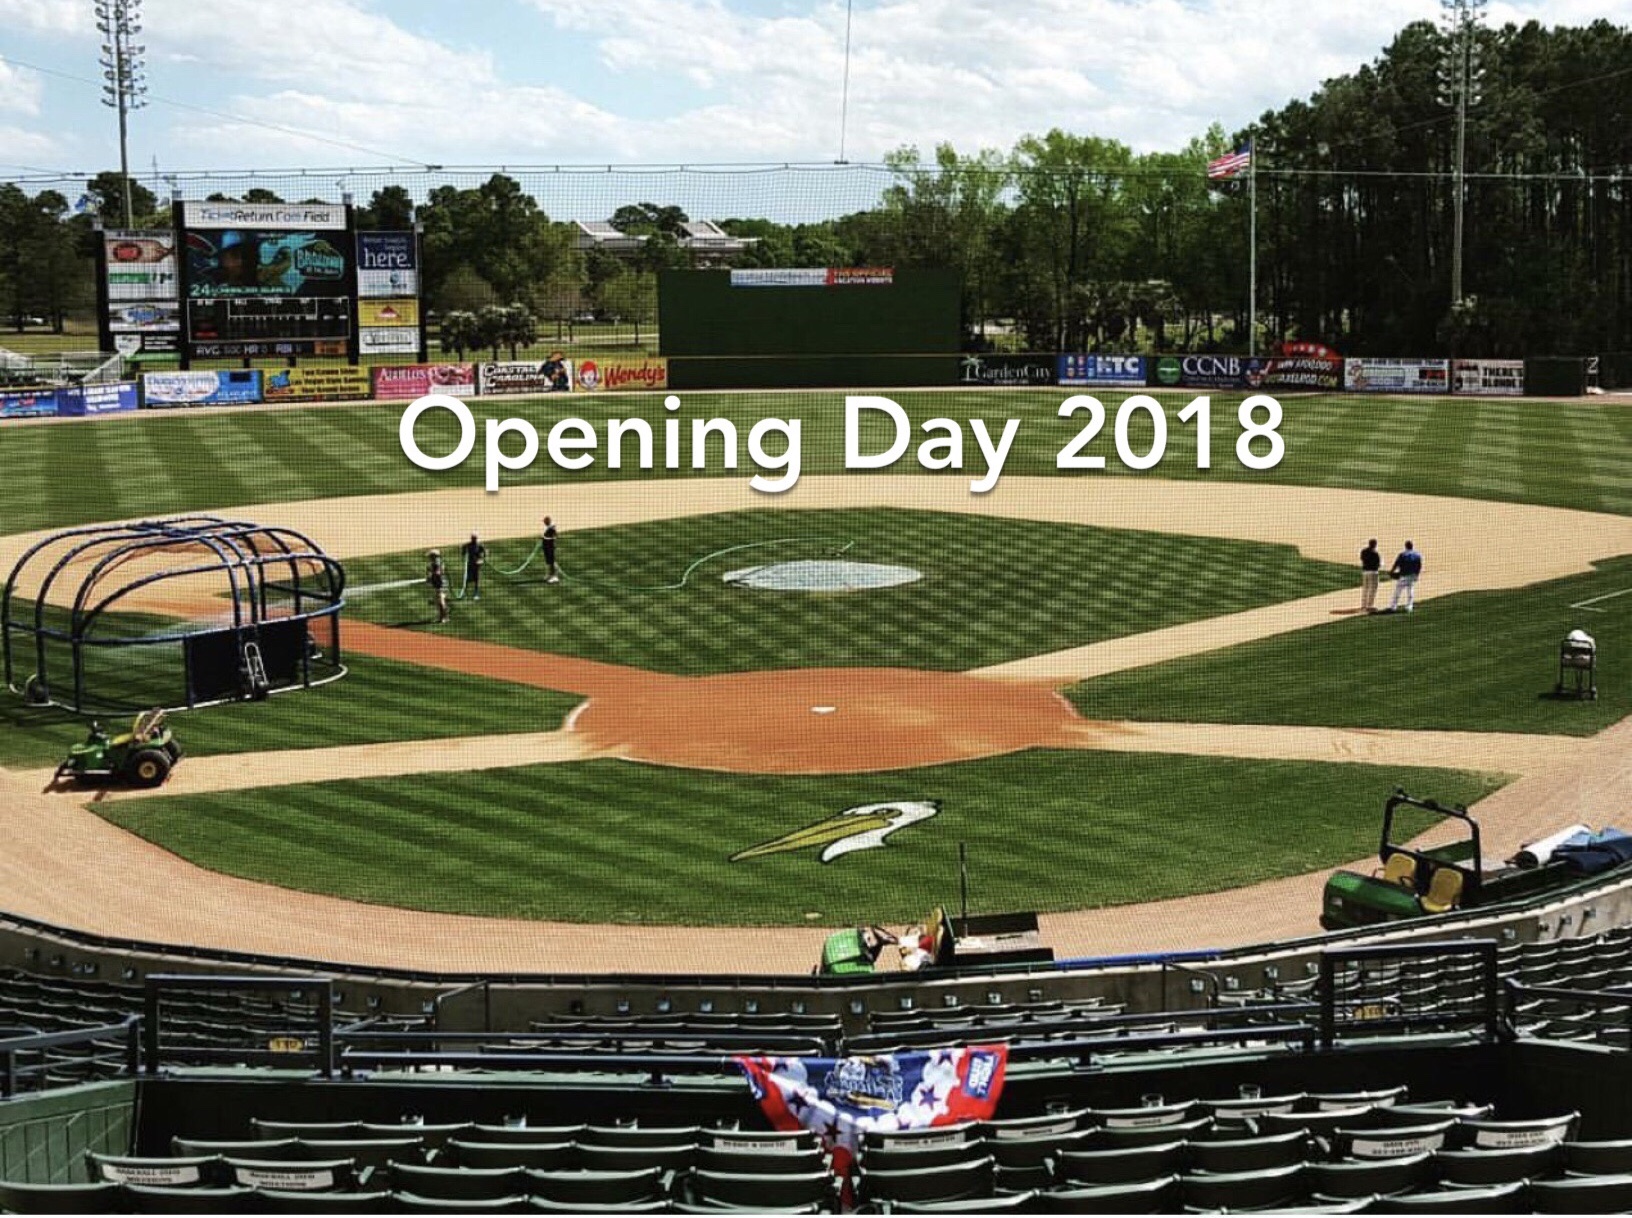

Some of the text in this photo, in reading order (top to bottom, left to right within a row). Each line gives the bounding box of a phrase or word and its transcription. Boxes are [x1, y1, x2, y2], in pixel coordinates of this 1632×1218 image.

[364, 246, 412, 268] here.
[604, 361, 666, 388] Wendy's
[1182, 357, 1241, 376] CCNB
